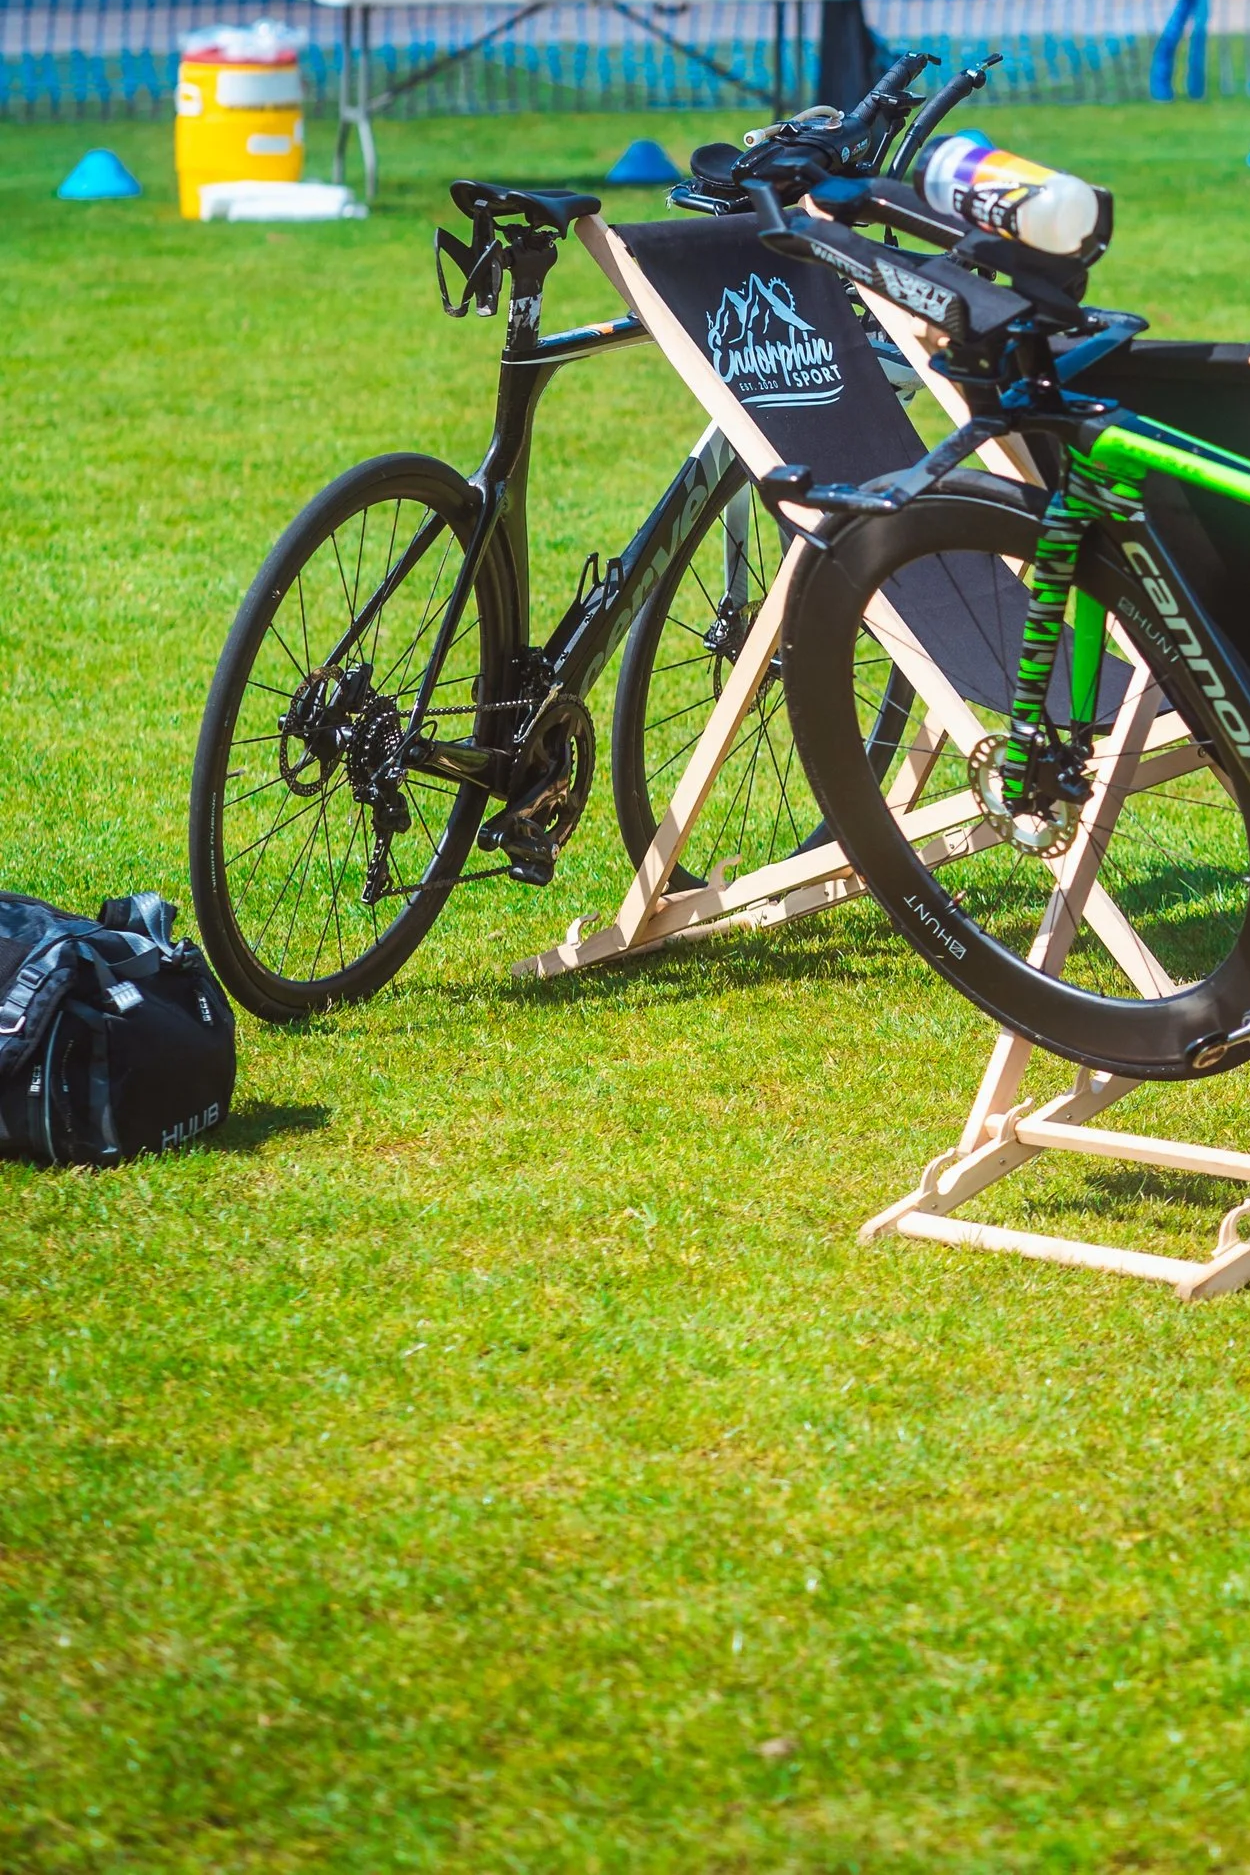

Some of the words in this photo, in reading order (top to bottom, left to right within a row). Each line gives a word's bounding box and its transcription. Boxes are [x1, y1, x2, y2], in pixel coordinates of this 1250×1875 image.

[708, 325, 833, 387] Endorphin
[793, 364, 842, 388] SPORT
[739, 382, 757, 392] EST.
[760, 380, 779, 390] 2020
[903, 895, 953, 946] HUNT
[161, 1102, 219, 1150] HUUB
